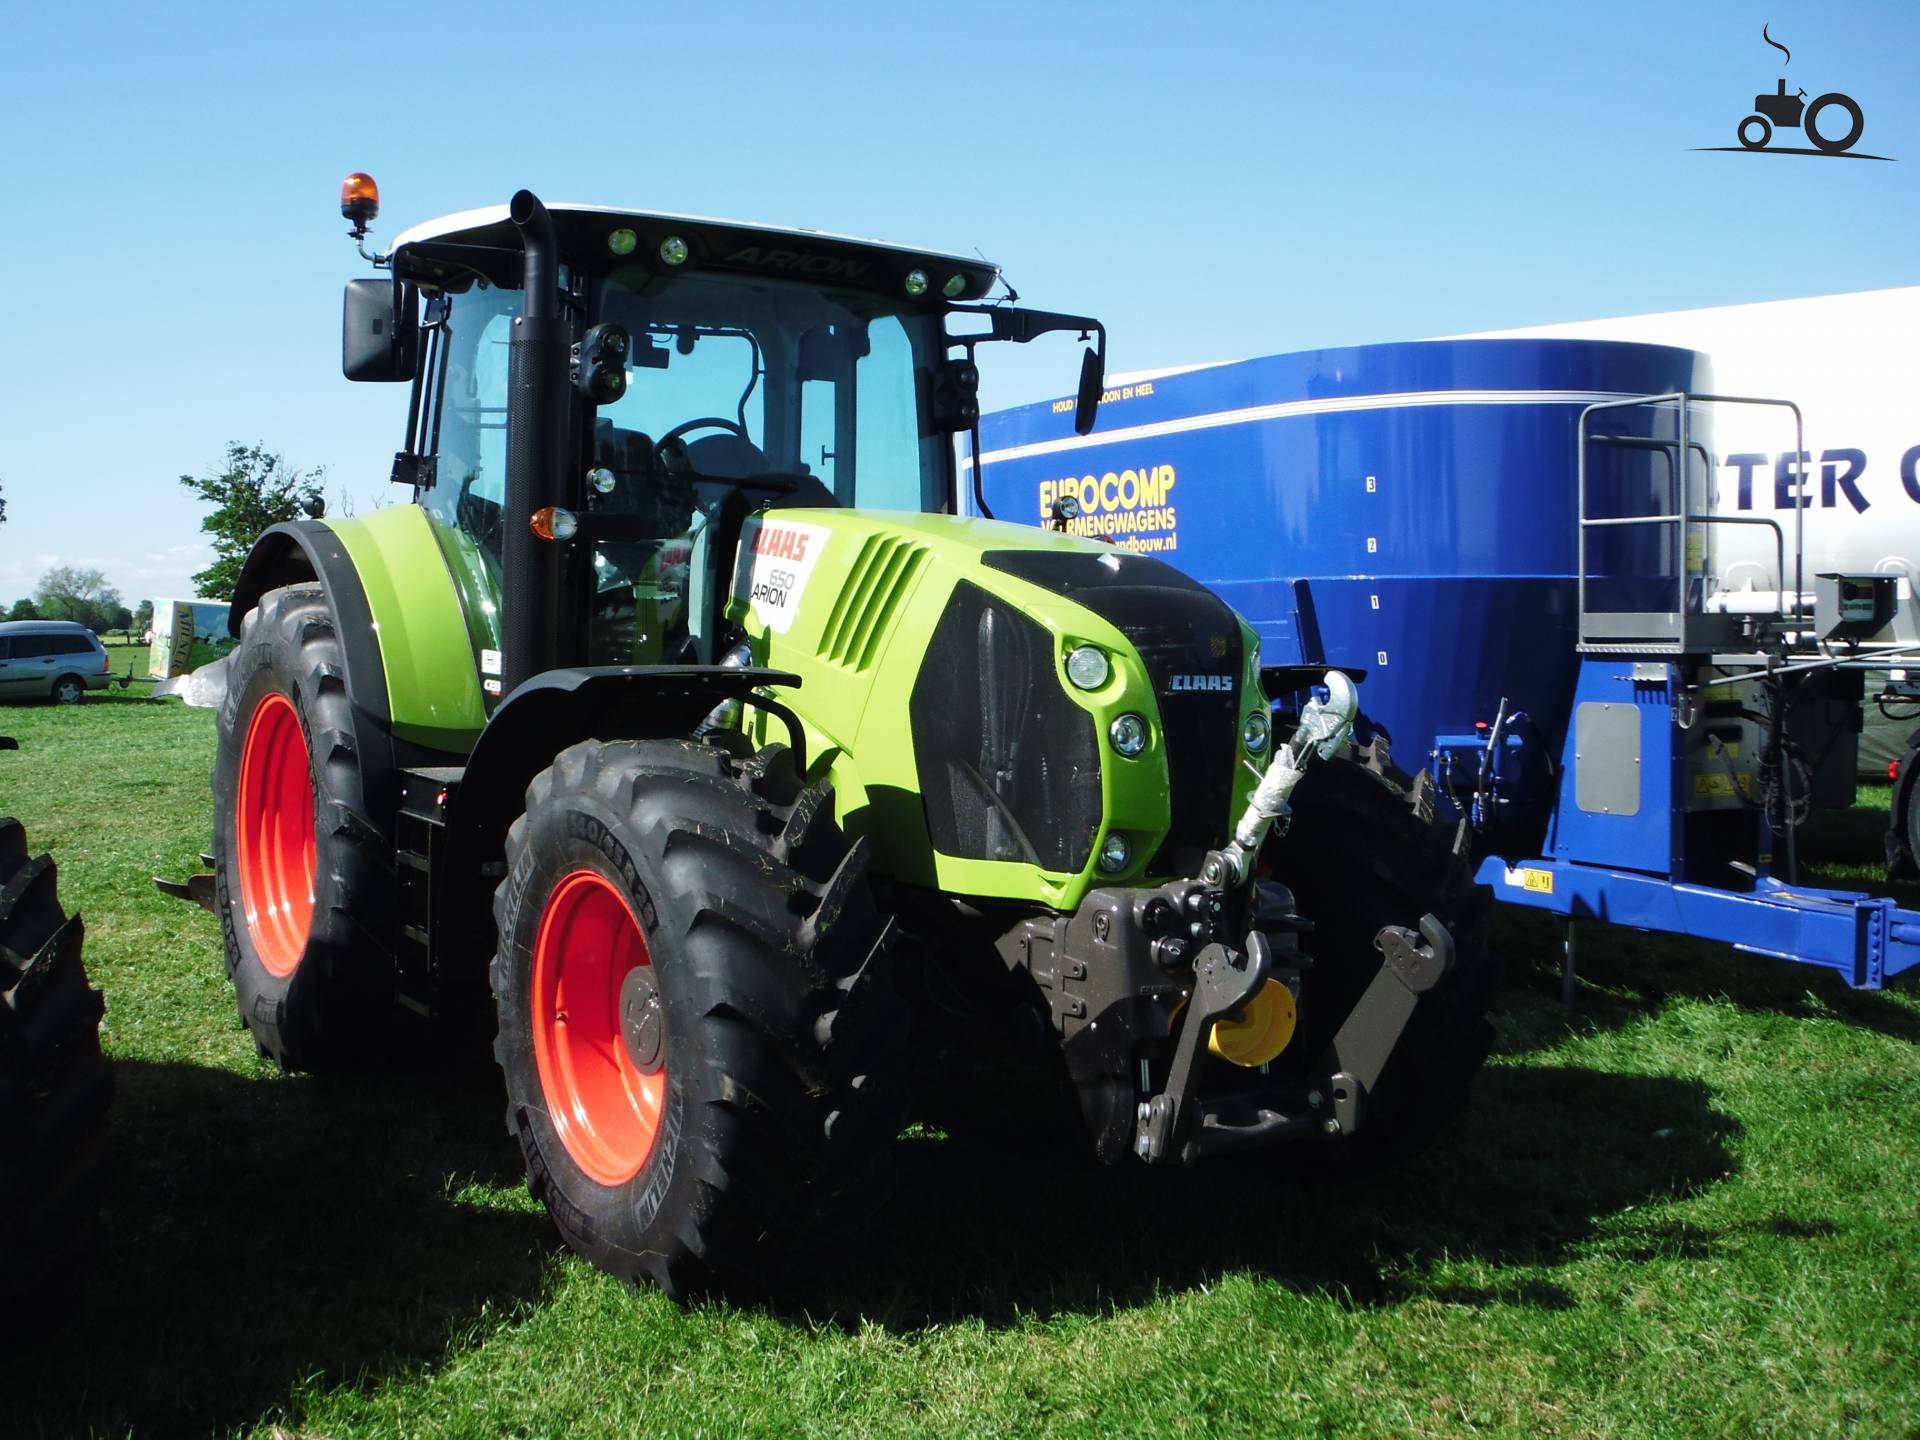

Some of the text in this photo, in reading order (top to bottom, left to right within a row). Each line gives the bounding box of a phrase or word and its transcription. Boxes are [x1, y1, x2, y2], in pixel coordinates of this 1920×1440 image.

[721, 245, 874, 280] ARION
[1122, 386, 1134, 399] EN
[1135, 383, 1155, 397] HEEL
[1717, 447, 1871, 514] TER
[750, 527, 810, 562] CLAAS
[769, 568, 795, 590] 650
[750, 582, 788, 608] ARION
[1171, 674, 1233, 691] CLAAS
